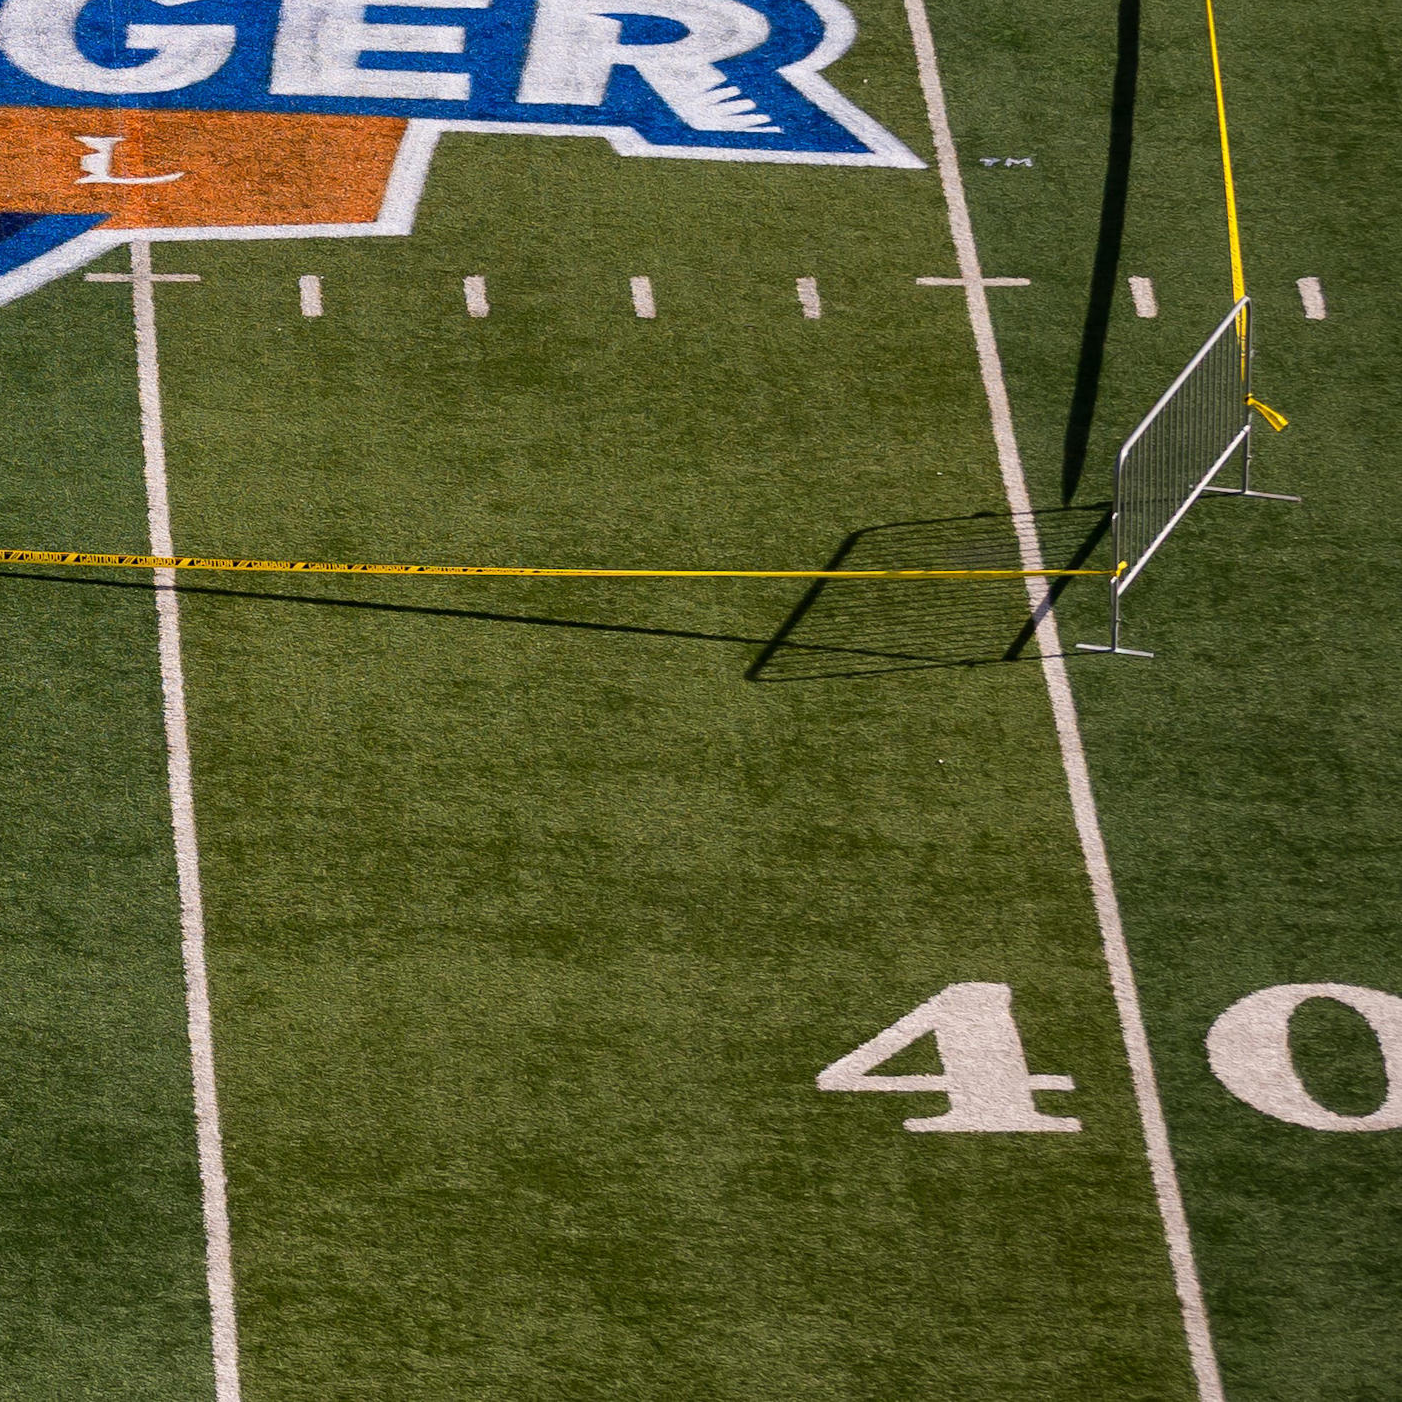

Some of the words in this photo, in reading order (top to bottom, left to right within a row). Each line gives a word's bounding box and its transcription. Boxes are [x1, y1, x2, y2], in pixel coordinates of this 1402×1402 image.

[979, 157, 1034, 167] TM
[22, 553, 61, 563] CUIDADO
[79, 556, 118, 565] CAUTION
[137, 558, 175, 566] CUIDADO
[193, 560, 233, 568] CAUTION
